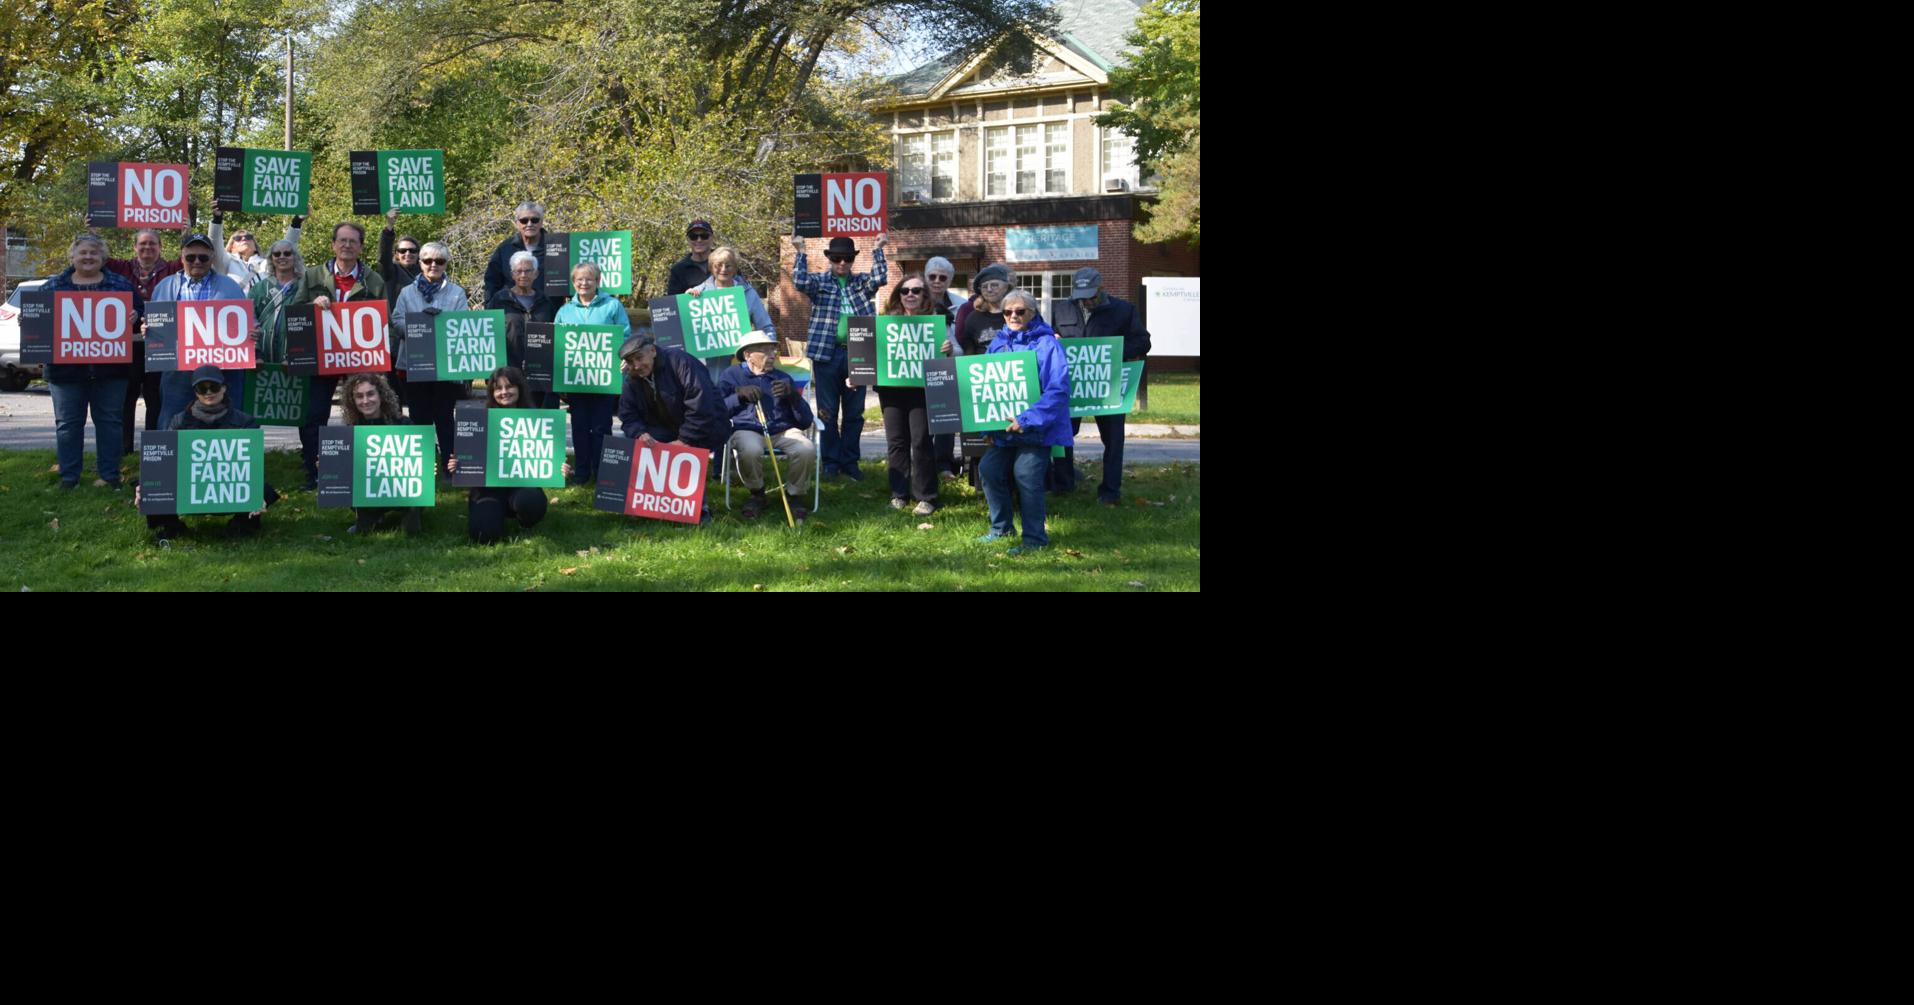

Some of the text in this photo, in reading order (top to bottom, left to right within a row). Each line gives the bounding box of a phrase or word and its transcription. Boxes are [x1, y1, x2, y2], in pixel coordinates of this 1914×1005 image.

[254, 156, 301, 176] SAVE
[388, 157, 433, 175] SAVE
[124, 168, 183, 208] NO
[253, 174, 300, 192] FARM
[389, 175, 434, 191] FARM
[252, 191, 299, 208] LAND
[390, 191, 435, 207] LAND
[827, 178, 881, 216] NO
[124, 208, 182, 223] PRISON
[828, 217, 881, 232] PRISON
[579, 238, 622, 256] SAVE
[599, 272, 622, 288] ND
[688, 295, 736, 317] SAVE
[61, 297, 126, 339] NO
[184, 305, 248, 346] NO
[322, 306, 382, 350] NO
[446, 318, 495, 337] SAVE
[692, 313, 740, 334] FARM
[565, 331, 613, 351] SAVE
[695, 330, 742, 352] LAND
[886, 323, 934, 343] SAVE
[61, 341, 126, 357] PRISON
[185, 347, 249, 365] PRISON
[447, 337, 495, 355] FARM
[887, 343, 935, 360] FARM
[1066, 344, 1112, 364] SAVE
[324, 350, 384, 368] PRISON
[447, 354, 496, 373] LAND
[564, 350, 612, 369] FARM
[256, 369, 303, 389] SAVE
[564, 368, 611, 386] LAND
[887, 361, 922, 379] LAN
[969, 359, 1026, 385] SAVE
[254, 387, 303, 404] FARM
[971, 381, 1028, 404] FARM
[1070, 381, 1110, 398] AND
[254, 403, 301, 420] LAND
[500, 417, 554, 439] SAVE
[191, 438, 250, 462] SAVE
[366, 434, 423, 456] SAVE
[499, 439, 553, 458] FARM
[191, 462, 250, 482] FARM
[366, 457, 422, 477] FARM
[498, 459, 553, 479] LAND
[635, 447, 701, 497] NO
[191, 483, 250, 505] LAND
[366, 477, 422, 498] LAND
[632, 492, 696, 517] PRISON
